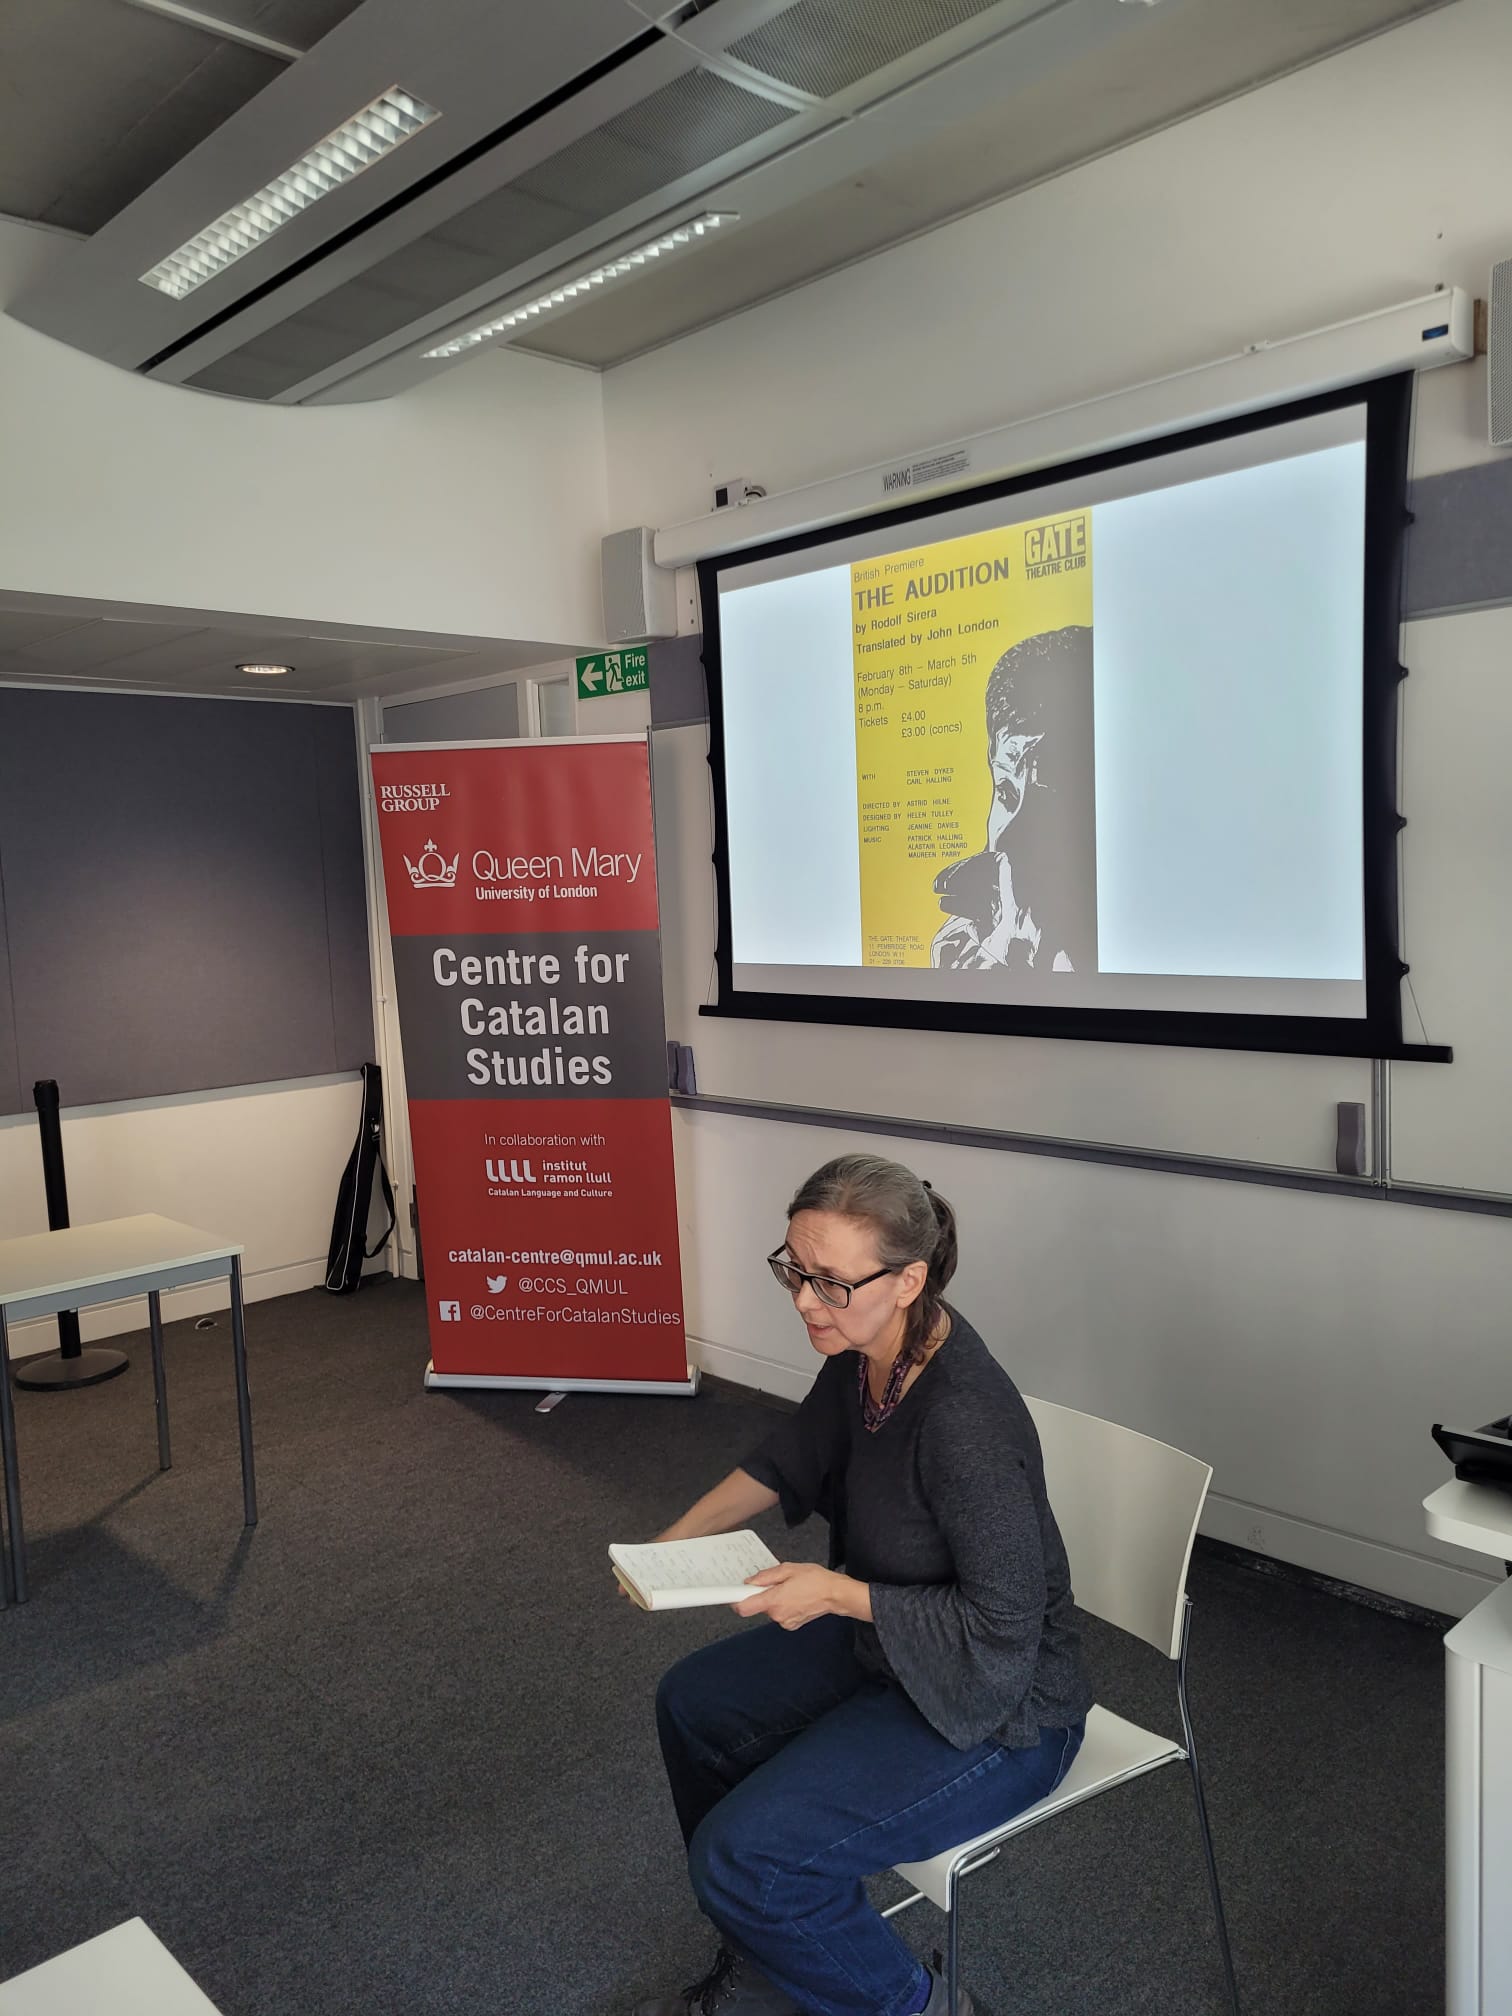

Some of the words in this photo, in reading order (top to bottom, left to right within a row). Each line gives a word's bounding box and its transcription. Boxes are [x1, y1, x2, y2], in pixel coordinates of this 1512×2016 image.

[883, 468, 911, 491] WARNING
[1025, 516, 1086, 566] GATE
[854, 569, 880, 583] British
[884, 558, 924, 576] Premiere
[1026, 563, 1062, 580] THEATRE
[1064, 556, 1086, 571] CLUB
[855, 584, 894, 611] THE
[905, 557, 1009, 601] AUDITION
[856, 621, 866, 633] by
[871, 615, 901, 630] Rodolf
[907, 608, 937, 623] Sirera
[856, 636, 905, 654] Translated
[910, 633, 922, 644] by
[927, 628, 952, 641] John
[958, 619, 999, 635] London
[625, 653, 645, 669] Fire
[857, 668, 894, 683] February
[899, 665, 913, 676] 8th
[927, 657, 956, 671] March
[961, 653, 977, 665] 5th
[626, 671, 645, 686] exit
[858, 684, 894, 699] (Monday
[908, 673, 952, 690] Saturday)
[858, 703, 863, 713] 8
[866, 702, 884, 713] p.m.
[859, 714, 889, 728] Tickets
[901, 711, 926, 723] £4.00
[901, 727, 926, 738] £3.00
[929, 721, 962, 736] (concs)
[926, 776, 952, 784] HALLING
[380, 784, 451, 798] RUSSELL
[381, 797, 440, 812] GROUP
[472, 849, 563, 882] Queen
[571, 847, 642, 883] Mary
[475, 886, 535, 902] University
[538, 886, 550, 899] of
[553, 885, 597, 899] London
[433, 948, 560, 986] Centre
[575, 945, 629, 984] for
[460, 997, 609, 1036] Catalan
[466, 1046, 613, 1086] Studies
[484, 1134, 496, 1145] In
[500, 1135, 576, 1147] collaboration
[580, 1135, 606, 1146] with
[542, 1160, 587, 1171] institut
[543, 1174, 583, 1183] ramon
[586, 1172, 611, 1183] llull
[488, 1188, 520, 1197] Catalan
[521, 1188, 562, 1199] Language
[580, 1189, 613, 1197] Culture
[449, 1248, 662, 1267] catalan-centre@qmul.ac.uk
[518, 1277, 628, 1296] @CCS_QMUL
[470, 1305, 681, 1325] @CentreForCatalanStudies
